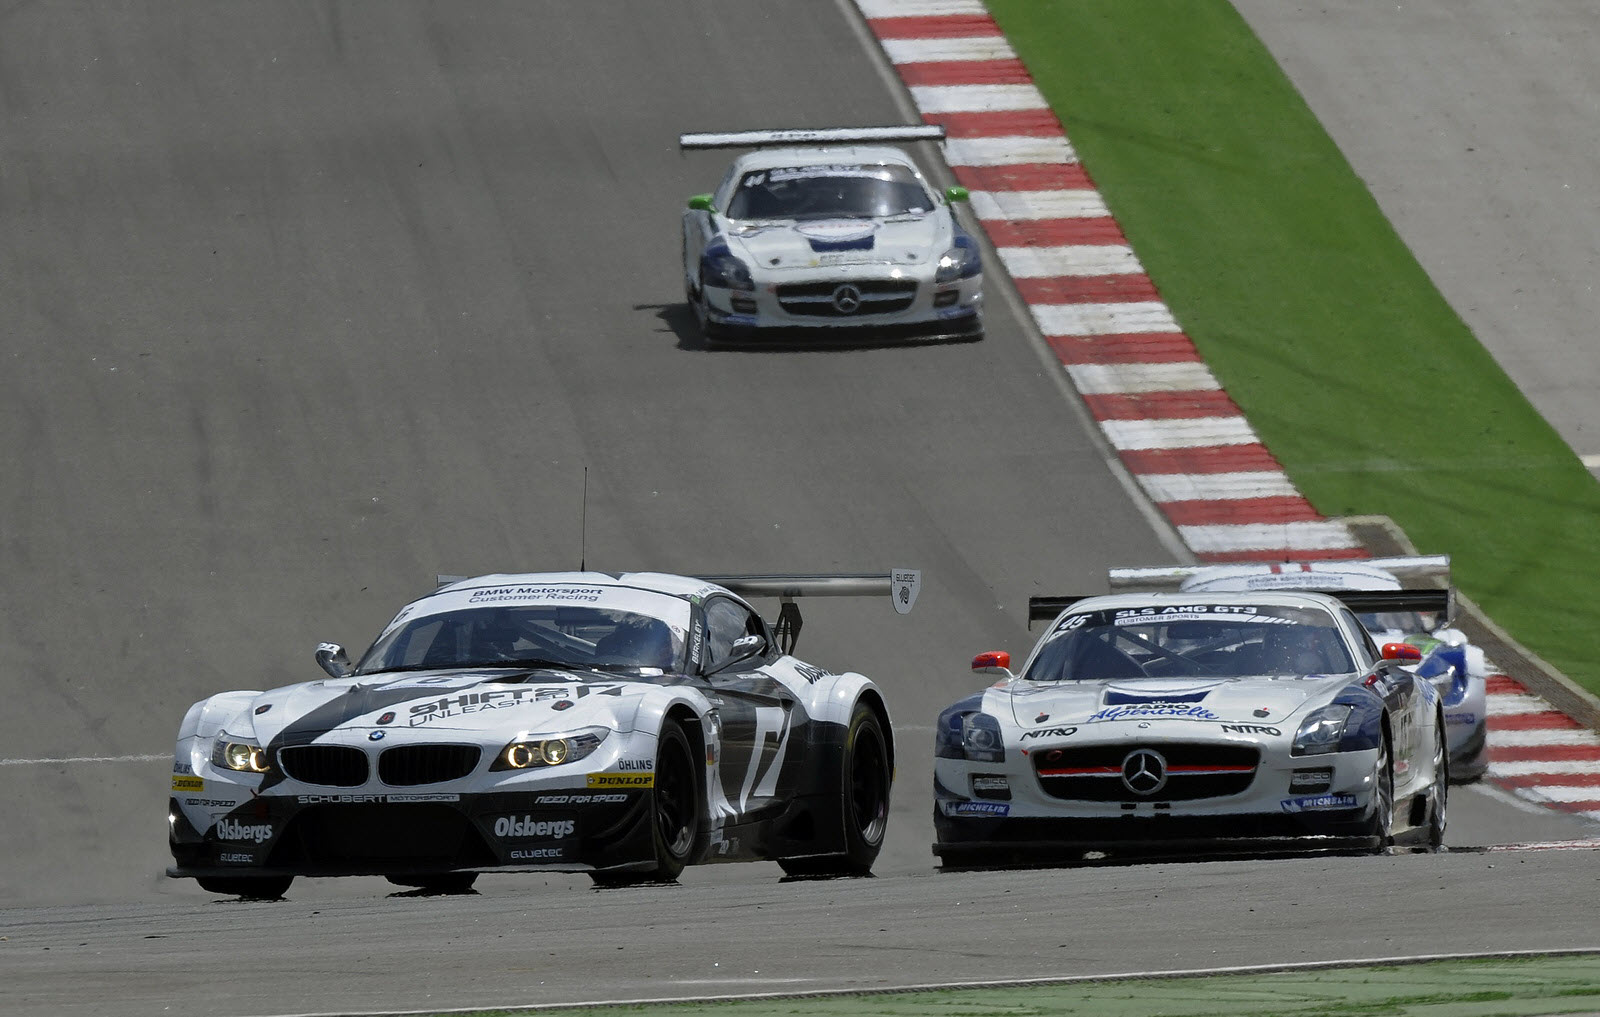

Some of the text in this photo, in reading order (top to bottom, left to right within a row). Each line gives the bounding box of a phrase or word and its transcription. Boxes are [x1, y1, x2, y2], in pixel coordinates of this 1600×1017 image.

[469, 593, 599, 603] Customer Racing
[472, 588, 514, 597] BMW
[1115, 605, 1257, 618] SLS AMG GT3
[1059, 614, 1092, 630] 45
[1117, 613, 1200, 625] CUSTOMER SPORTS
[691, 618, 702, 665] BERKELEY
[409, 687, 568, 716] SHIFT2
[409, 692, 570, 727] UNLEASHED
[1087, 706, 1219, 724] Alpenwelle
[1020, 727, 1078, 742] NITRO
[1221, 724, 1282, 737] NITRO
[618, 758, 653, 770] ÖHLINS
[598, 776, 653, 785] DUNLOP
[298, 794, 387, 804] SCHUBERT
[535, 794, 628, 804] NEED FOR SPEED
[1302, 795, 1355, 807] MICHELIN
[958, 803, 1006, 812] MICHELIN
[216, 819, 273, 844] Olsbergs
[494, 814, 575, 839] Olsbergs
